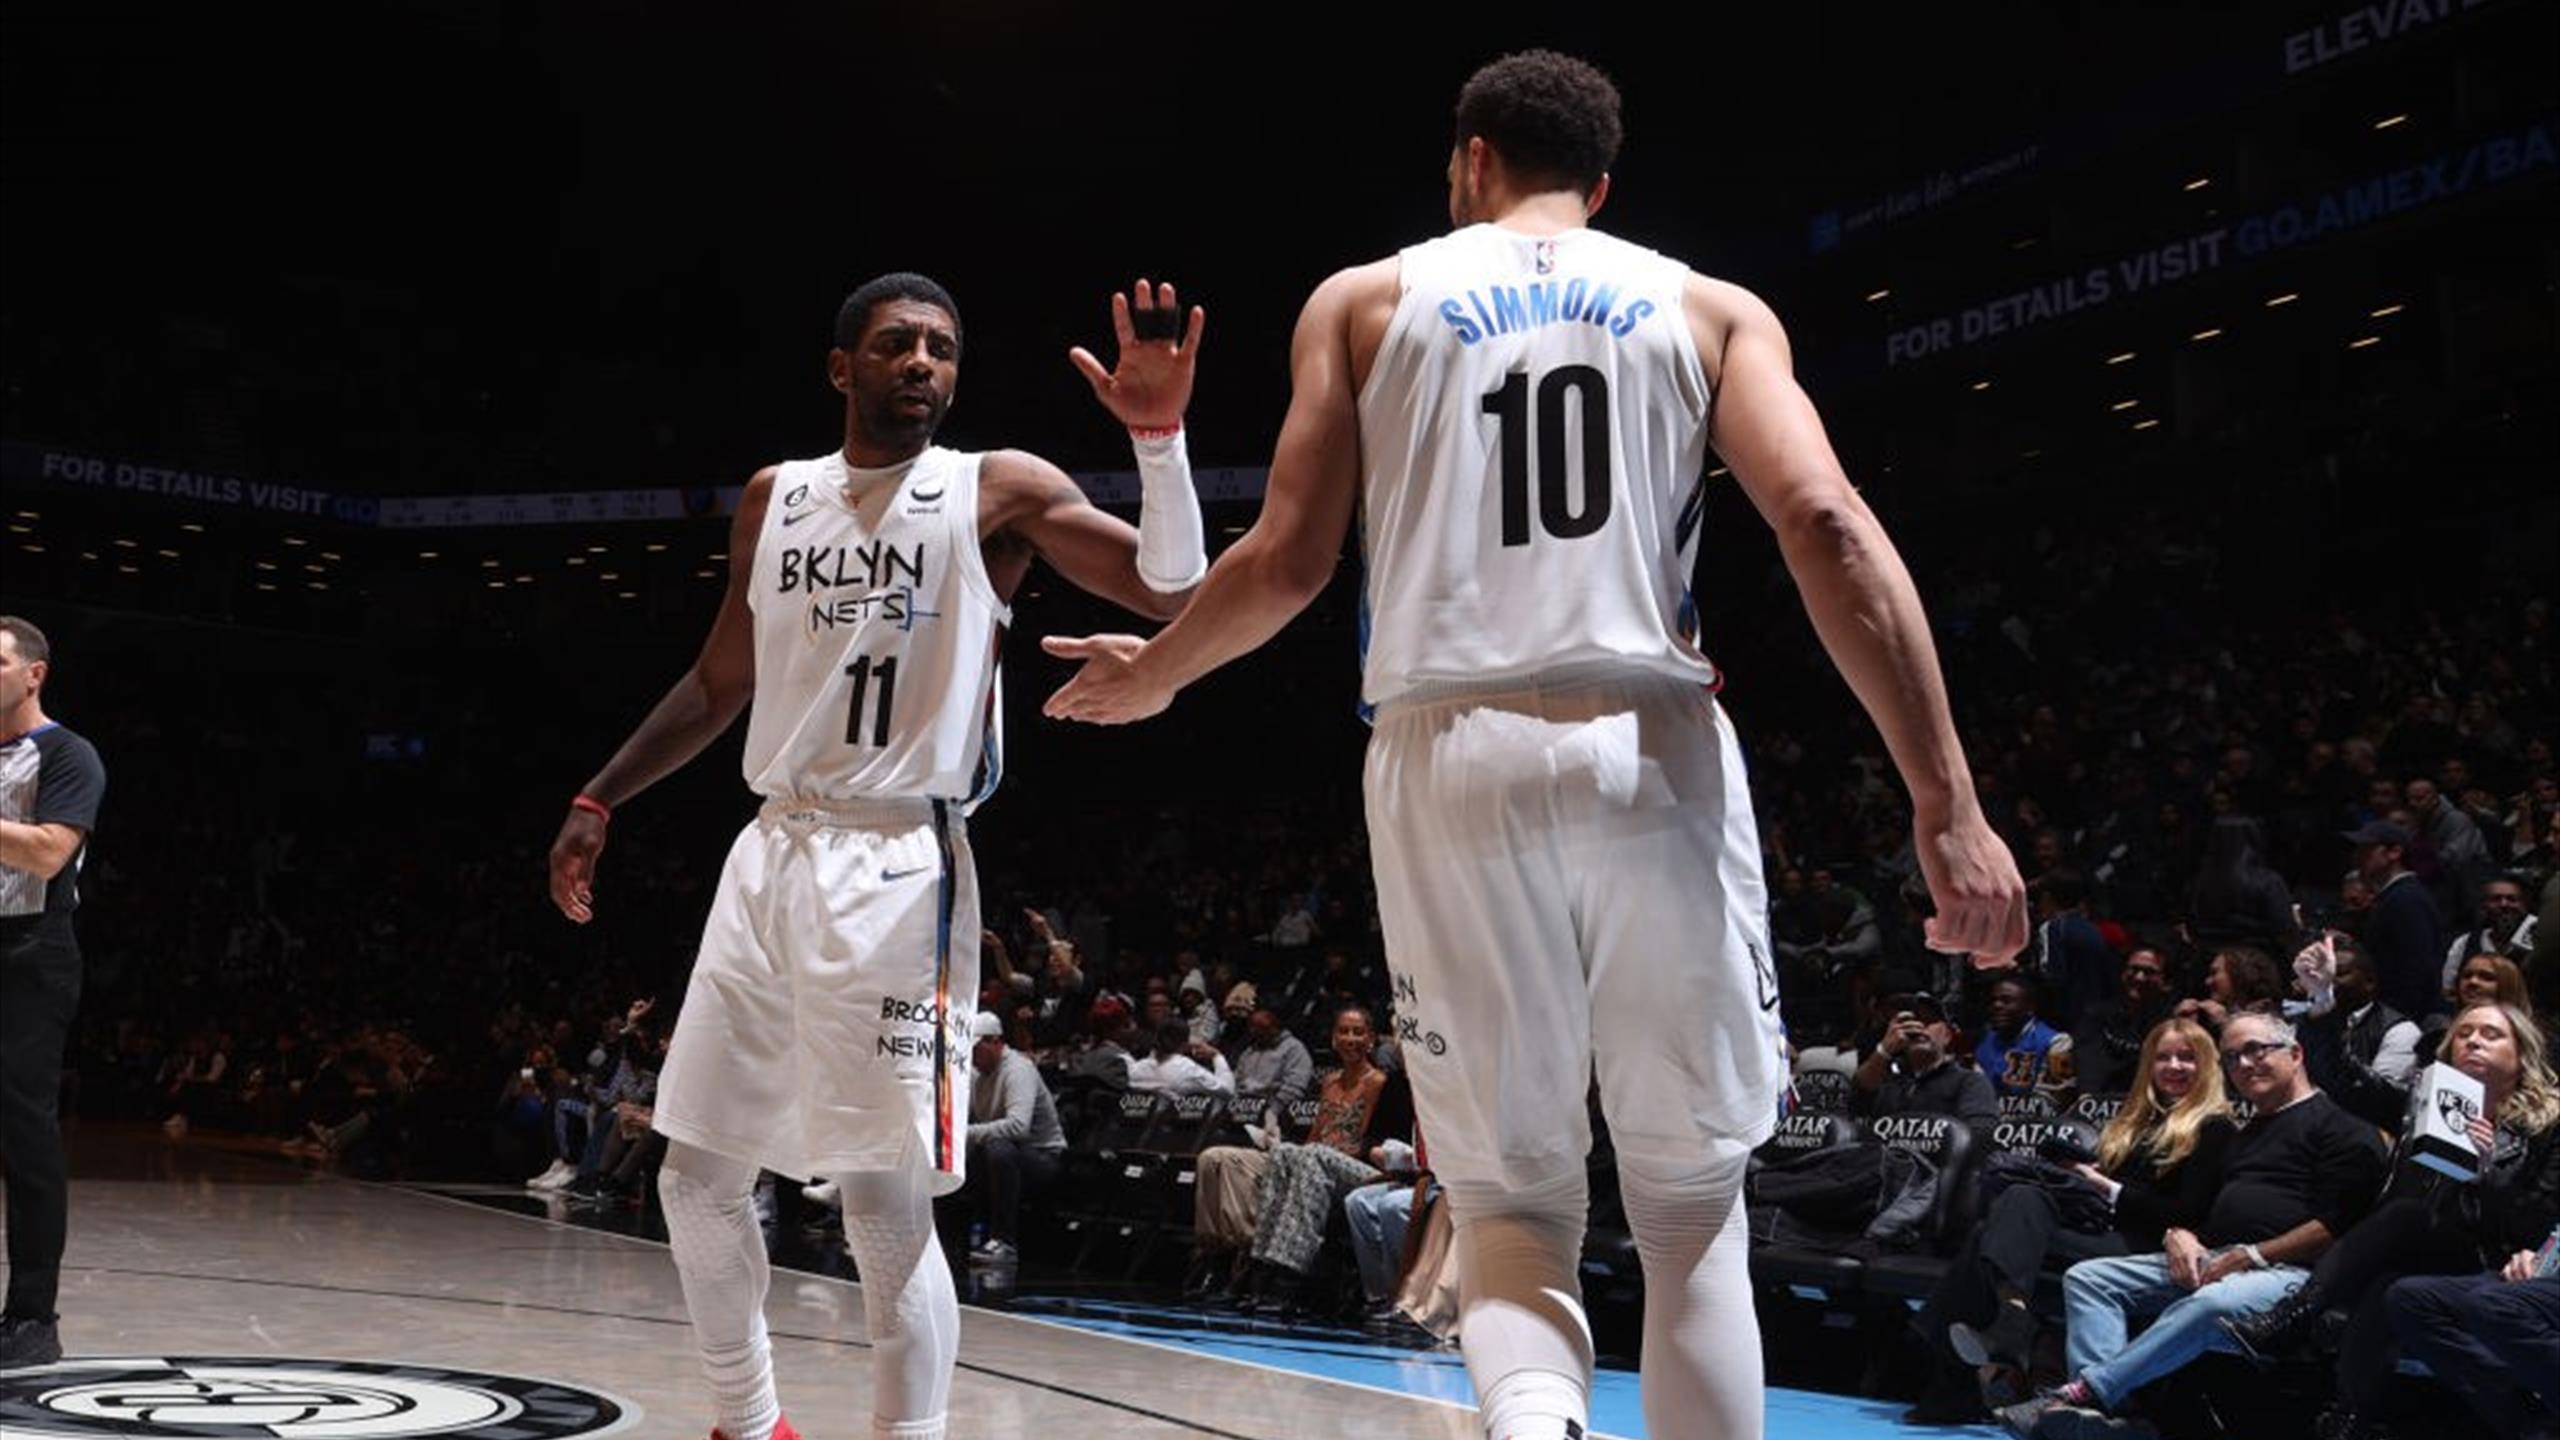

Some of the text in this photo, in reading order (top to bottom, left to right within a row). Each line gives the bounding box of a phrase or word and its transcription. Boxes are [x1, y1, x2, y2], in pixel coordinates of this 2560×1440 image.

[2283, 0, 2480, 75] ELEVA
[1439, 277, 1655, 345] SIMMONS
[1886, 317, 1951, 366] FOR
[1961, 268, 2111, 342] DETAILS
[2119, 228, 2228, 292] VISIT
[42, 453, 104, 486] FOR
[115, 463, 241, 503] DETAILS
[249, 480, 329, 515] VISIT
[1481, 364, 1612, 547] 10
[778, 540, 924, 593] BKLYN
[845, 655, 897, 747] 11
[877, 1036, 934, 1060] NEW
[1873, 1116, 1949, 1140] QATAR
[1993, 1123, 2075, 1148] QATAR
[2079, 1099, 2123, 1120] QAT
